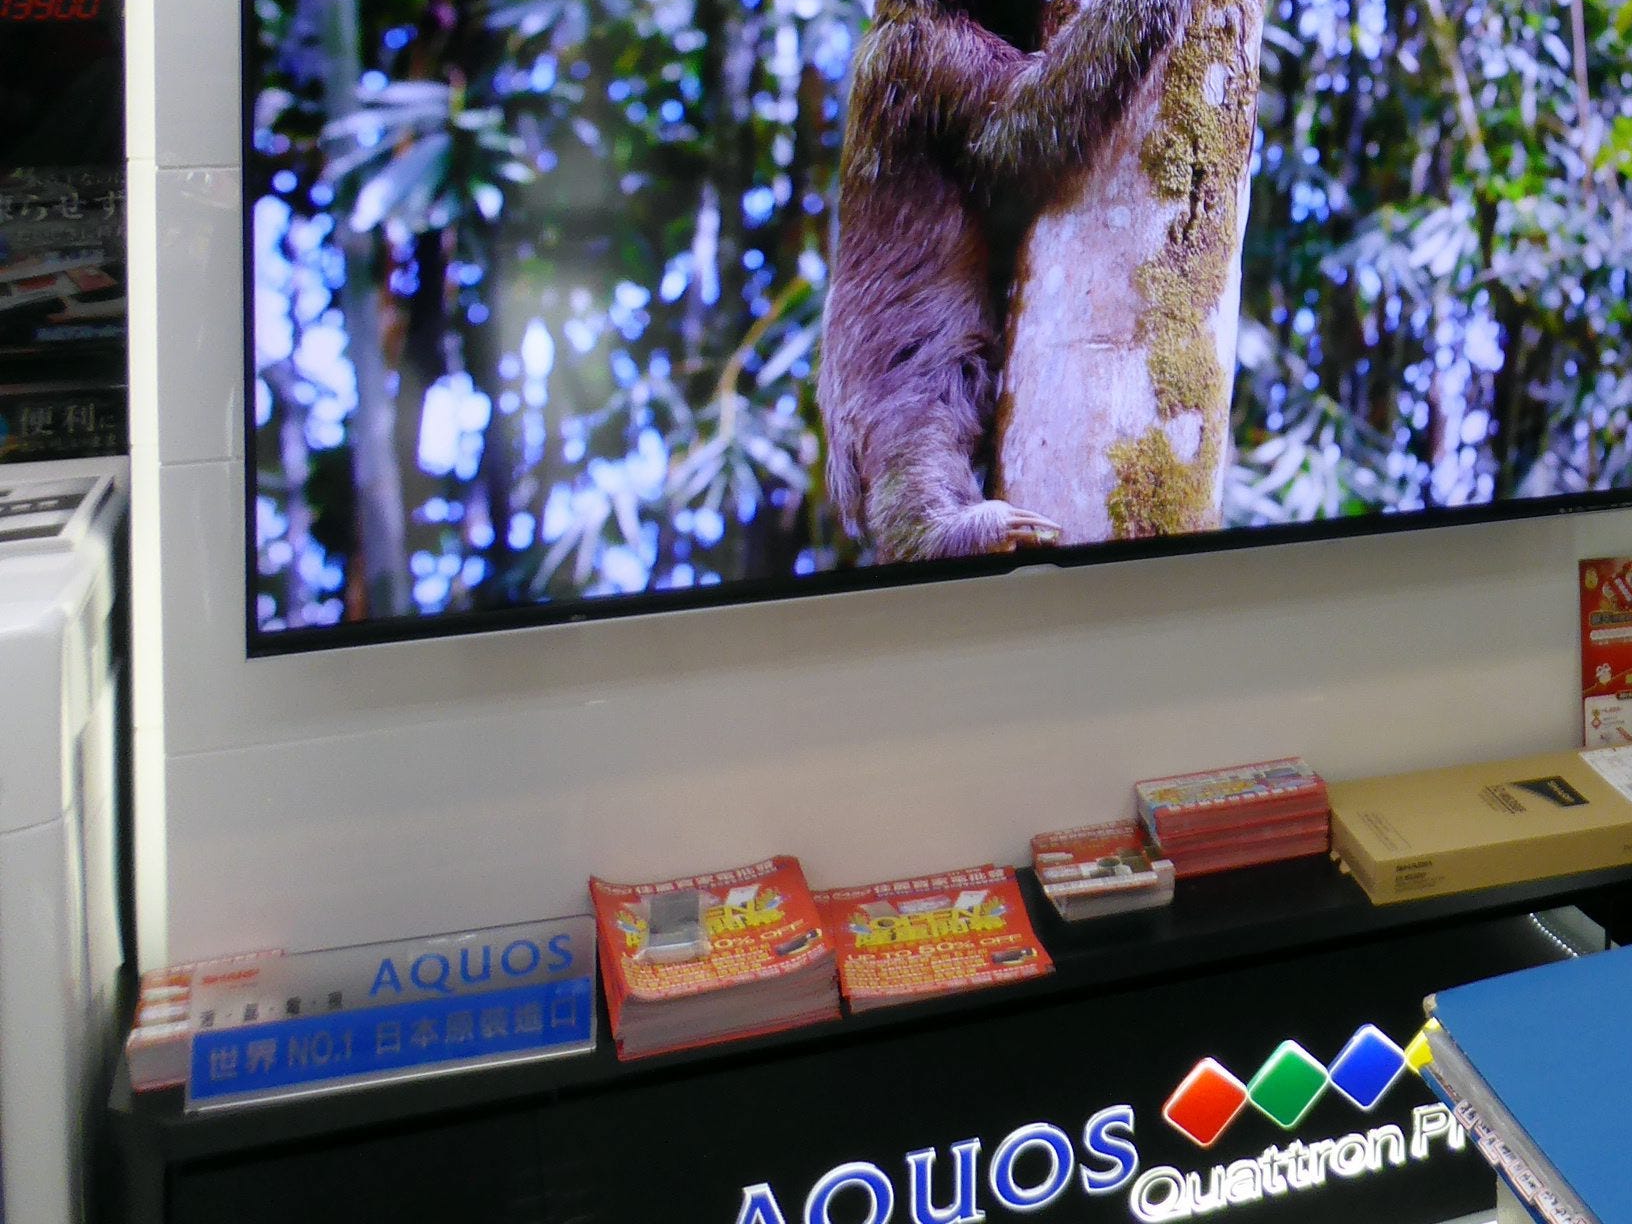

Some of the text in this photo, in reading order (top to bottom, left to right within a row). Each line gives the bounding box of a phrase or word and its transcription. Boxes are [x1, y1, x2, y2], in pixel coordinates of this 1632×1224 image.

[369, 934, 573, 997] AQUOS
[209, 1037, 277, 1083] 世界
[1130, 1123, 1401, 1223] Quattron
